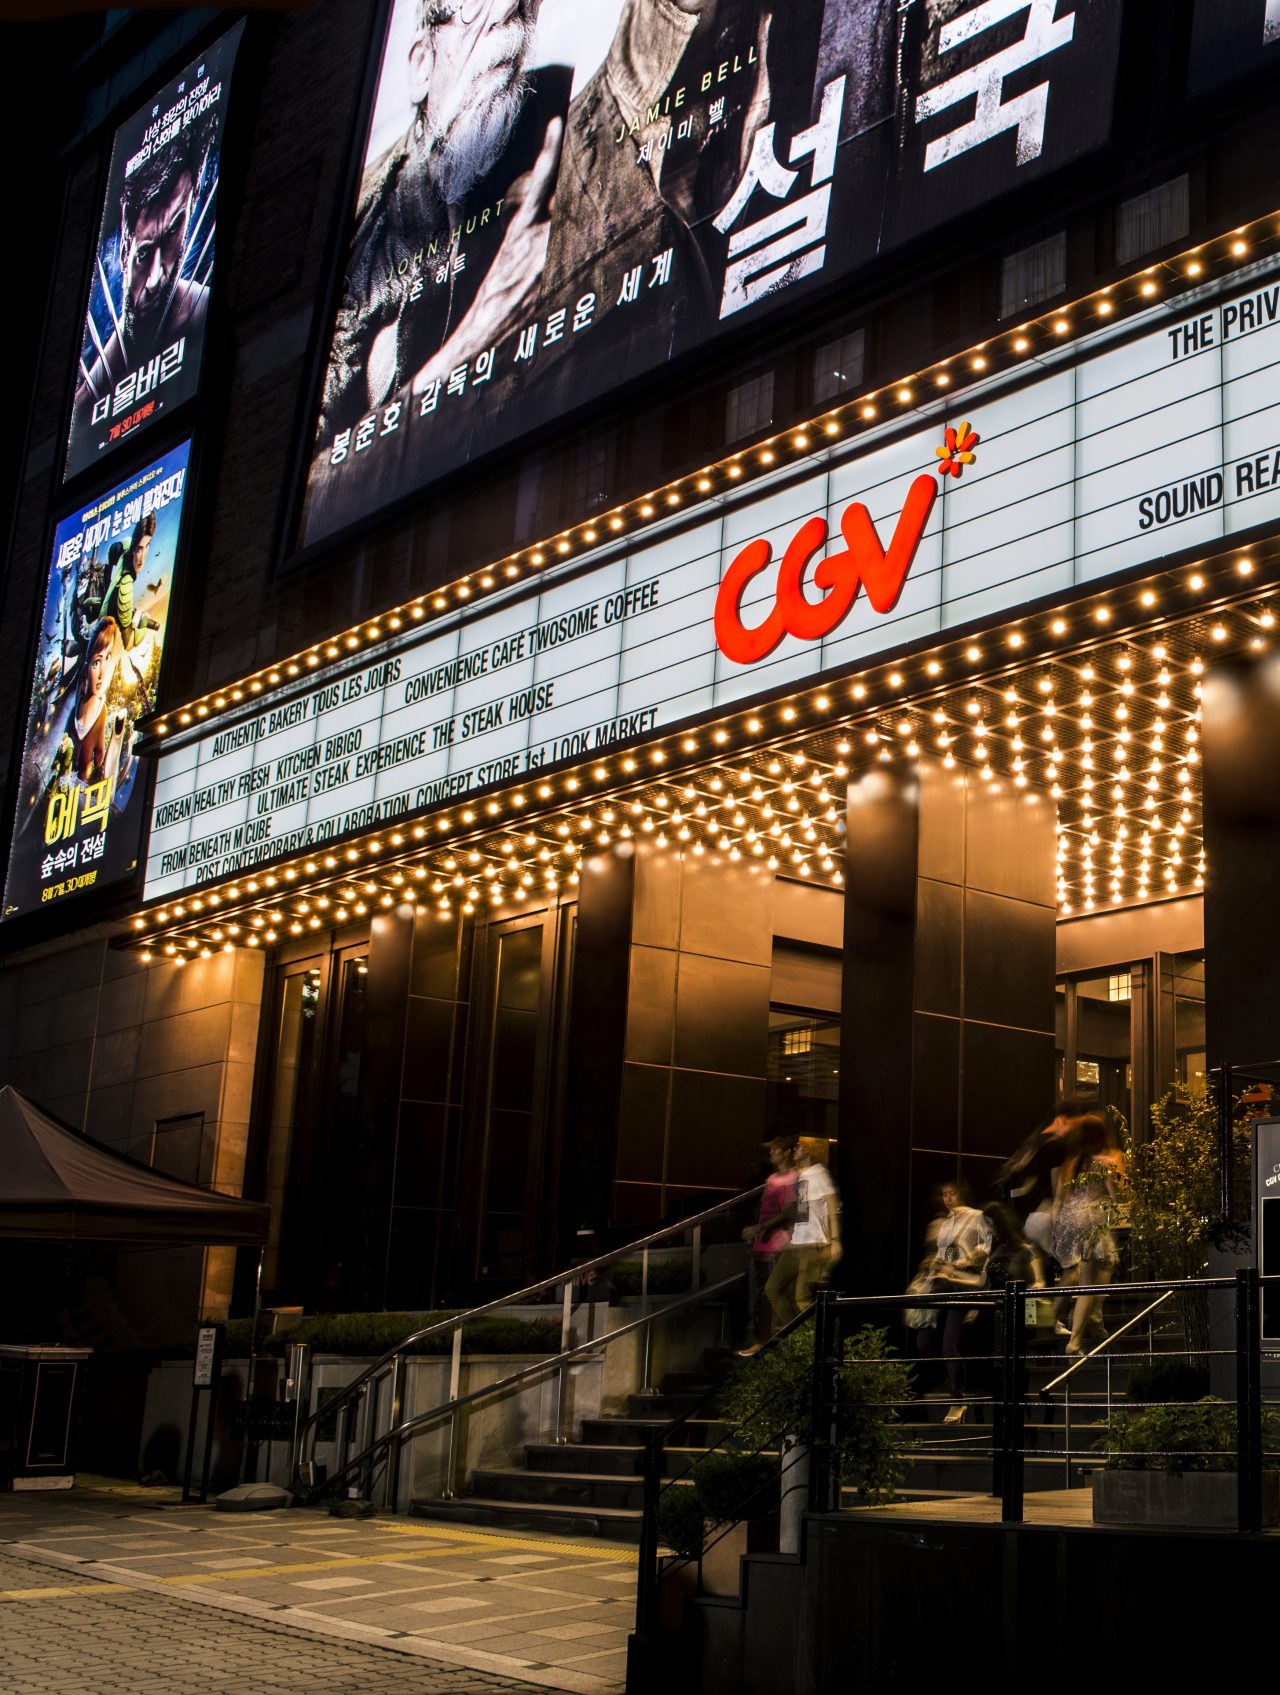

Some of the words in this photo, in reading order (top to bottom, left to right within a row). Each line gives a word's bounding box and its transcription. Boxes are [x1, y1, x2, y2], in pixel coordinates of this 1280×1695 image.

[616, 87, 686, 143] JAMIE
[701, 46, 757, 92] BELL
[636, 114, 693, 164] 제이미
[709, 96, 725, 125] 벨
[386, 239, 438, 283] JOHN
[451, 198, 504, 244] HURT
[409, 277, 424, 302] 존
[435, 253, 466, 284] 허트
[330, 401, 401, 465] 봉준호
[419, 346, 496, 416] 감독의
[513, 292, 596, 363] 새로운
[616, 247, 674, 306] 세계
[1168, 313, 1214, 359] THE
[91, 394, 111, 426] 더
[112, 336, 186, 417] 울버린
[56, 532, 83, 569] 새로운
[82, 515, 112, 553] 세계가
[111, 510, 122, 537] 눈
[122, 495, 143, 531] 앞에
[1138, 473, 1223, 530] SOUND
[714, 474, 938, 664] CGV
[405, 649, 489, 704] CONVENIENCE
[491, 630, 525, 670] CAFÉ
[529, 604, 599, 655] TWOSOME
[604, 580, 659, 625] COFFEE
[212, 716, 267, 758] AUTHENTIC
[269, 698, 310, 733] BAKERY
[313, 689, 340, 715] TOUS
[342, 678, 362, 702] LES
[364, 659, 401, 694] JOURS
[257, 777, 309, 814] ULTIMATE
[314, 760, 350, 793] STEAK
[355, 731, 426, 778] EXPERIENCE
[433, 716, 455, 749] THE
[462, 701, 504, 739] STEAK
[509, 683, 554, 722] HOUSE
[45, 775, 113, 846] 에픽
[155, 796, 191, 828] KOREAN
[194, 782, 235, 811] HEALTHY
[238, 765, 270, 797] FRESH
[276, 748, 322, 782] KITCHEN
[325, 728, 362, 762] BIBIGO
[196, 859, 221, 884] POST
[306, 824, 314, 845] &
[416, 770, 473, 808] CONCEPT
[477, 755, 520, 787] STORE
[553, 730, 590, 762] LOOK
[596, 707, 658, 748] MARKET
[41, 842, 78, 879] 숲속의
[80, 831, 106, 863] 전설
[161, 846, 186, 875] FROM
[188, 832, 231, 868] BENEATH
[233, 827, 243, 850] M
[245, 817, 272, 845] CUBE
[1265, 1175, 1277, 1187] CGV
